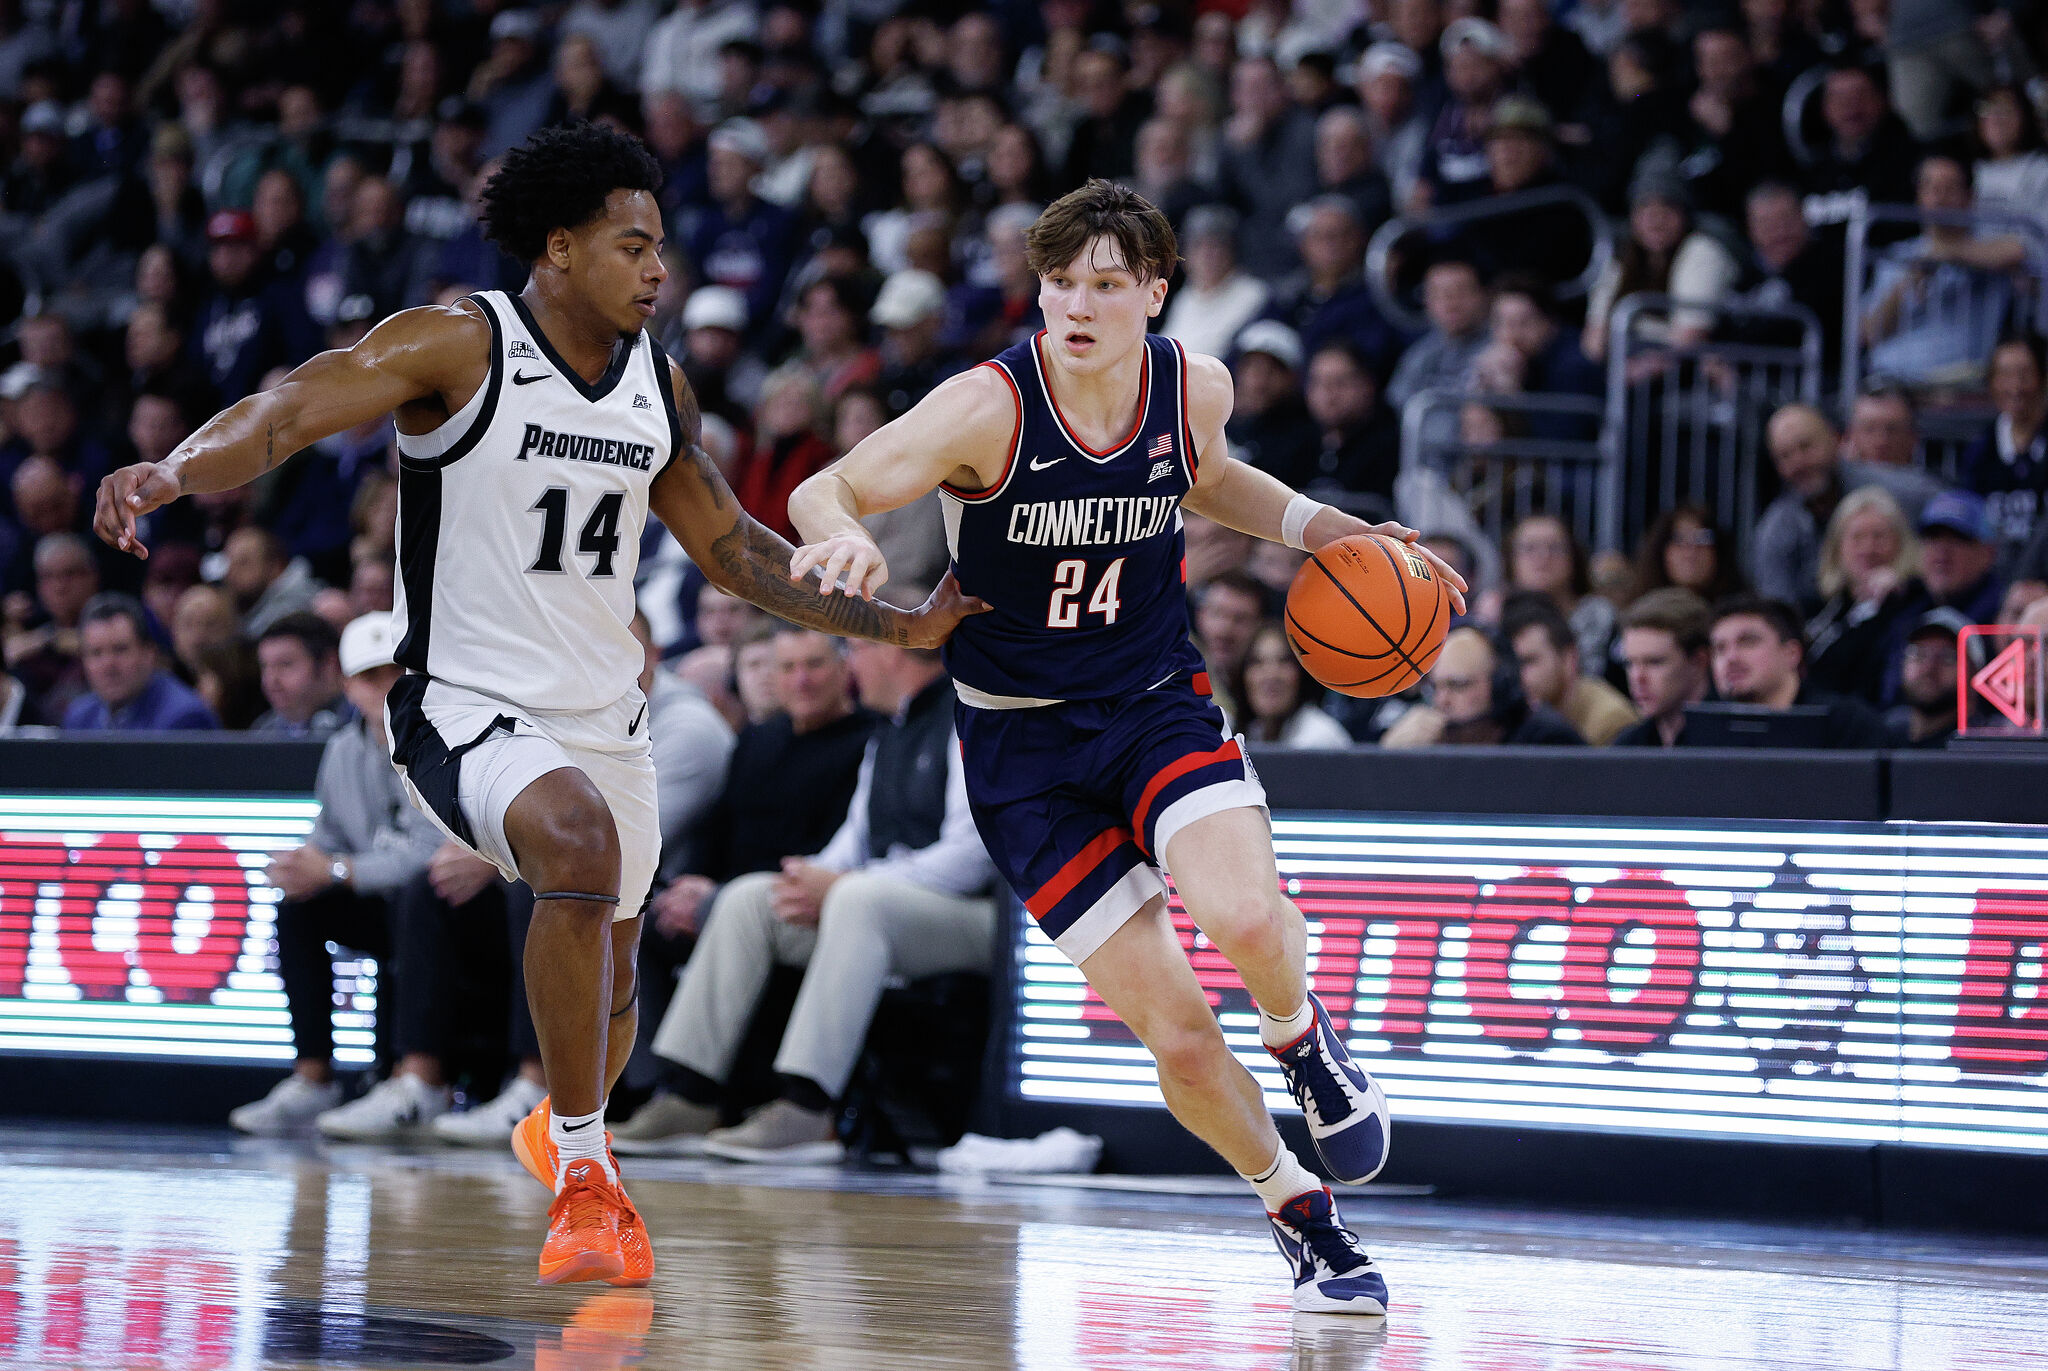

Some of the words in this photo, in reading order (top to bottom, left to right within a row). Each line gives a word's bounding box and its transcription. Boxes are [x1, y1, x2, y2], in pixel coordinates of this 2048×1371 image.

[512, 341, 523, 350] BE
[632, 400, 652, 409] EAST
[634, 393, 648, 403] BIG
[514, 422, 656, 473] PROVIDENCE
[1148, 465, 1175, 480] EAST
[1151, 459, 1171, 472] BIG
[1006, 495, 1179, 547] CONNECTICUT
[523, 485, 628, 580] 14
[1046, 556, 1129, 629] 24
